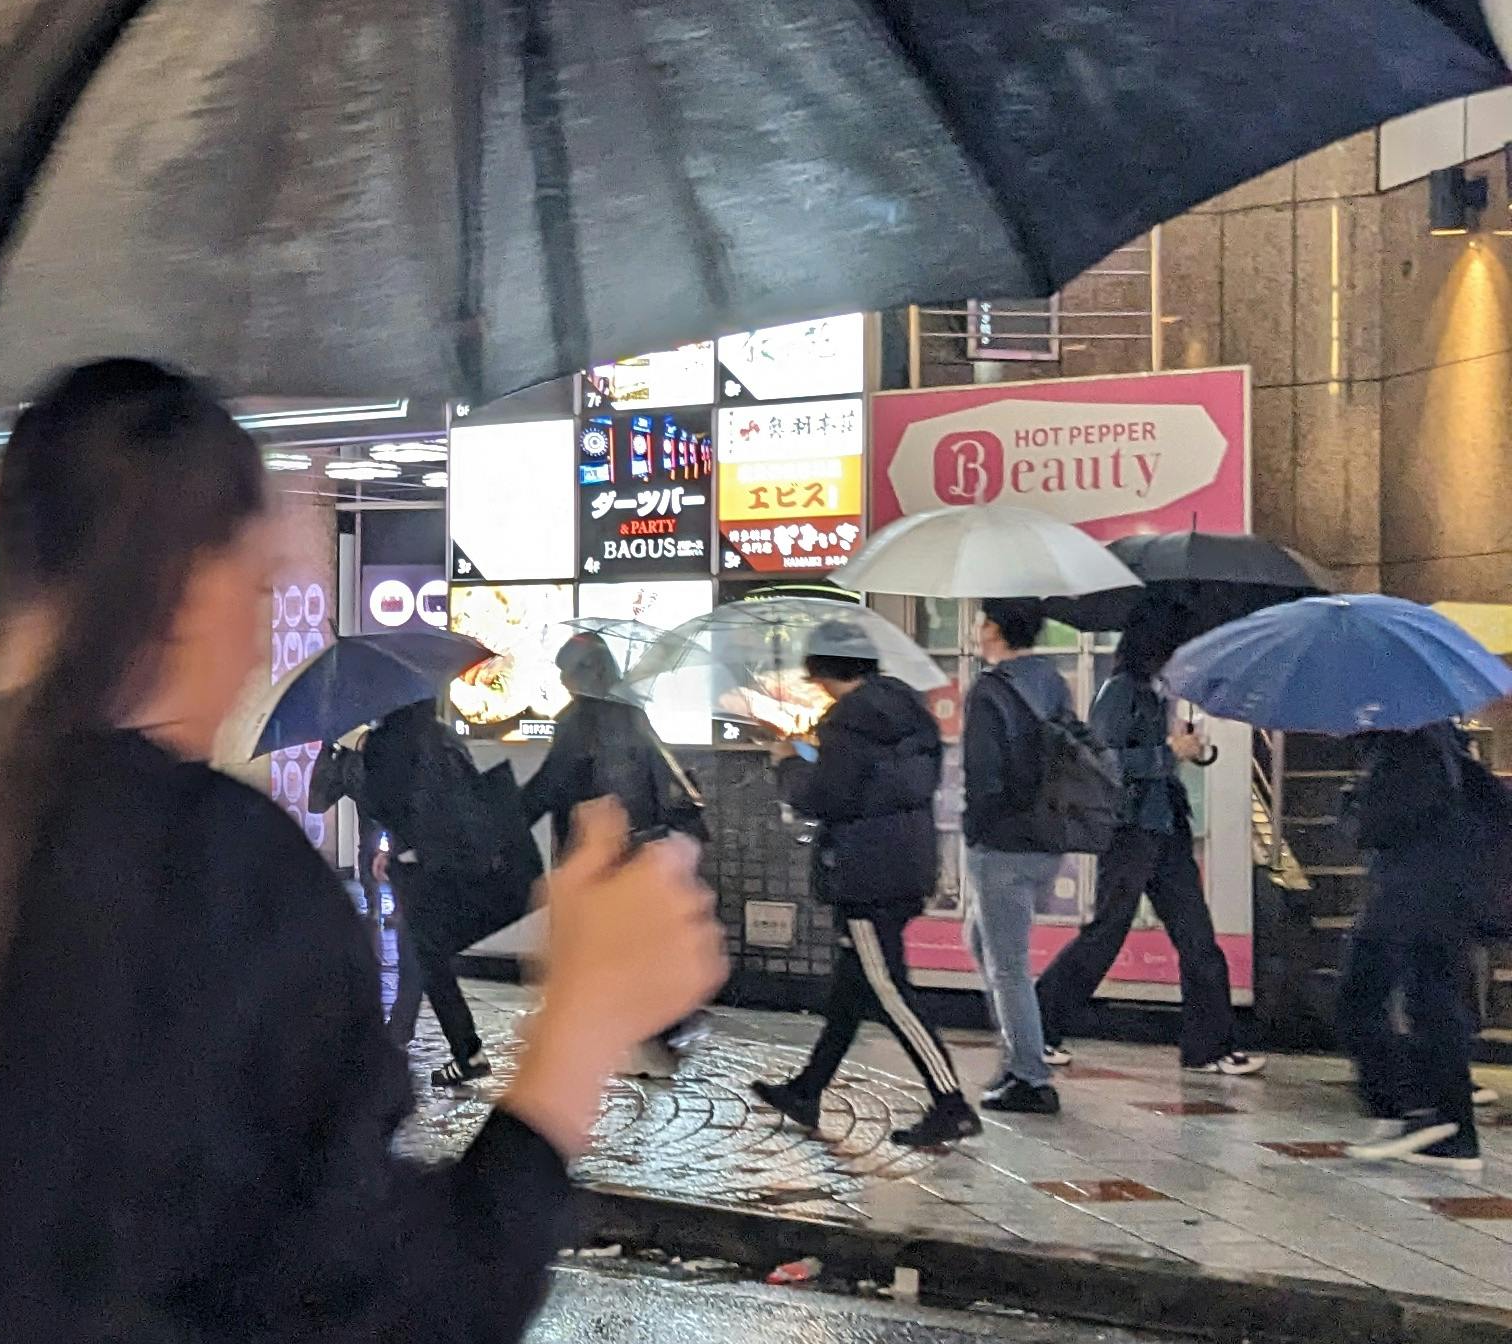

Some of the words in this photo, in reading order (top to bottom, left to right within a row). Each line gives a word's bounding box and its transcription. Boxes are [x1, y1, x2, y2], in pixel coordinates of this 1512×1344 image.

[1014, 426, 1063, 449] HOT
[1068, 421, 1156, 446] PEPPER
[948, 439, 1162, 498] Beauty
[591, 486, 706, 520] ダーツバー
[748, 482, 826, 510] エビス
[630, 518, 676, 535] PARTY
[603, 536, 676, 559] BAGUS
